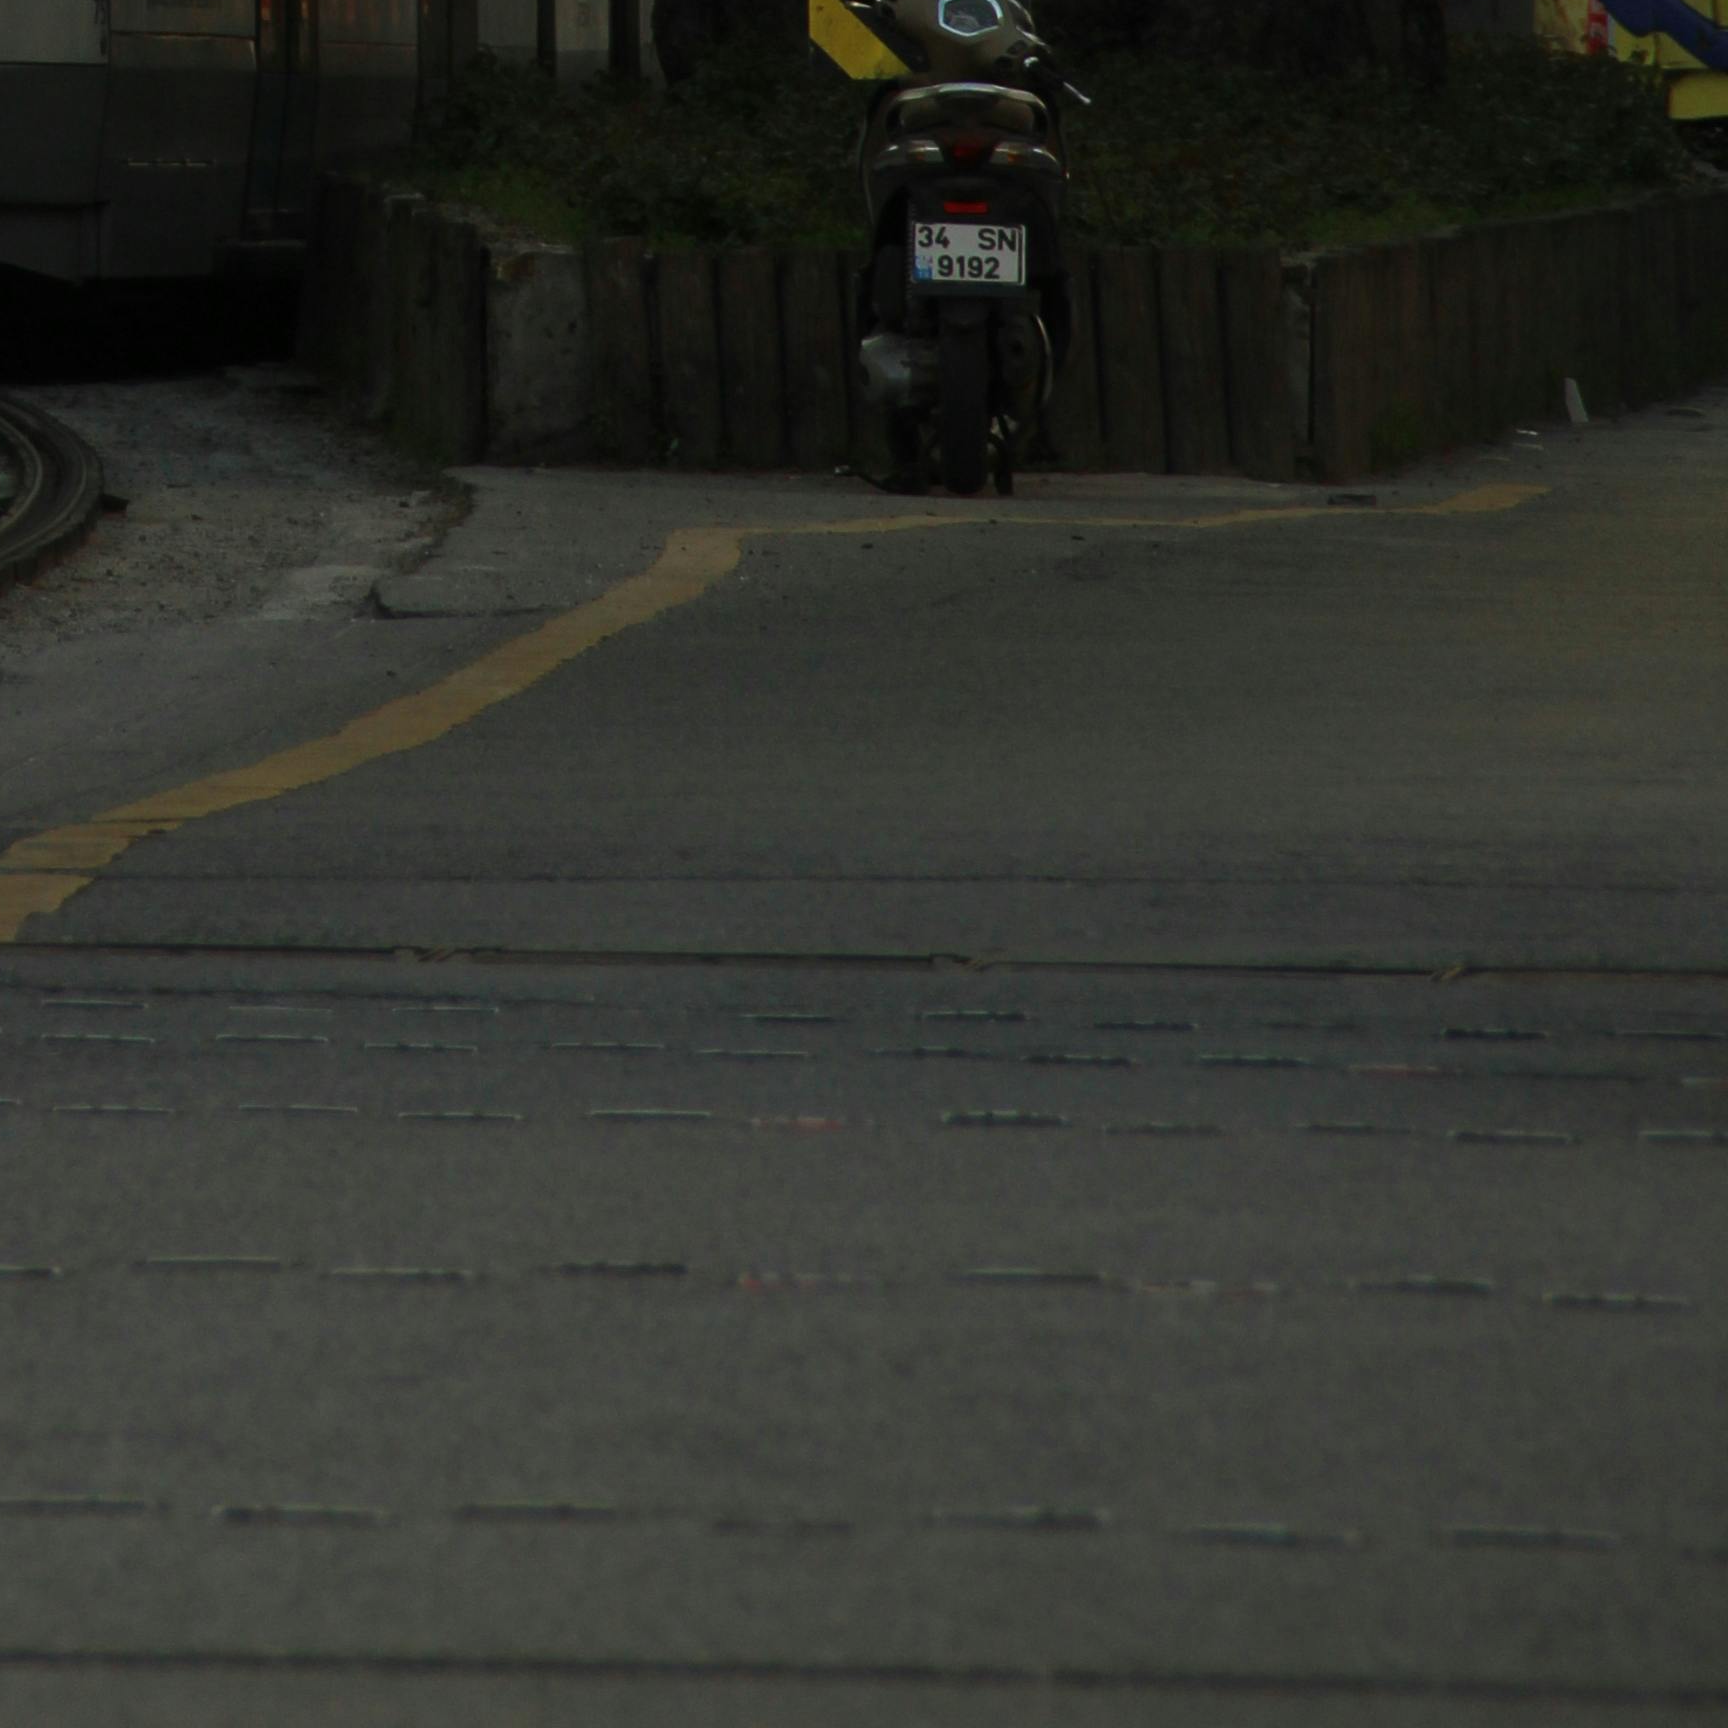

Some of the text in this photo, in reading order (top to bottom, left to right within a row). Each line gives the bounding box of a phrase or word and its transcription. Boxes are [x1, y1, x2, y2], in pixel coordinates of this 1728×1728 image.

[918, 225, 1017, 252] 34 SN
[937, 255, 1000, 280] 9192
